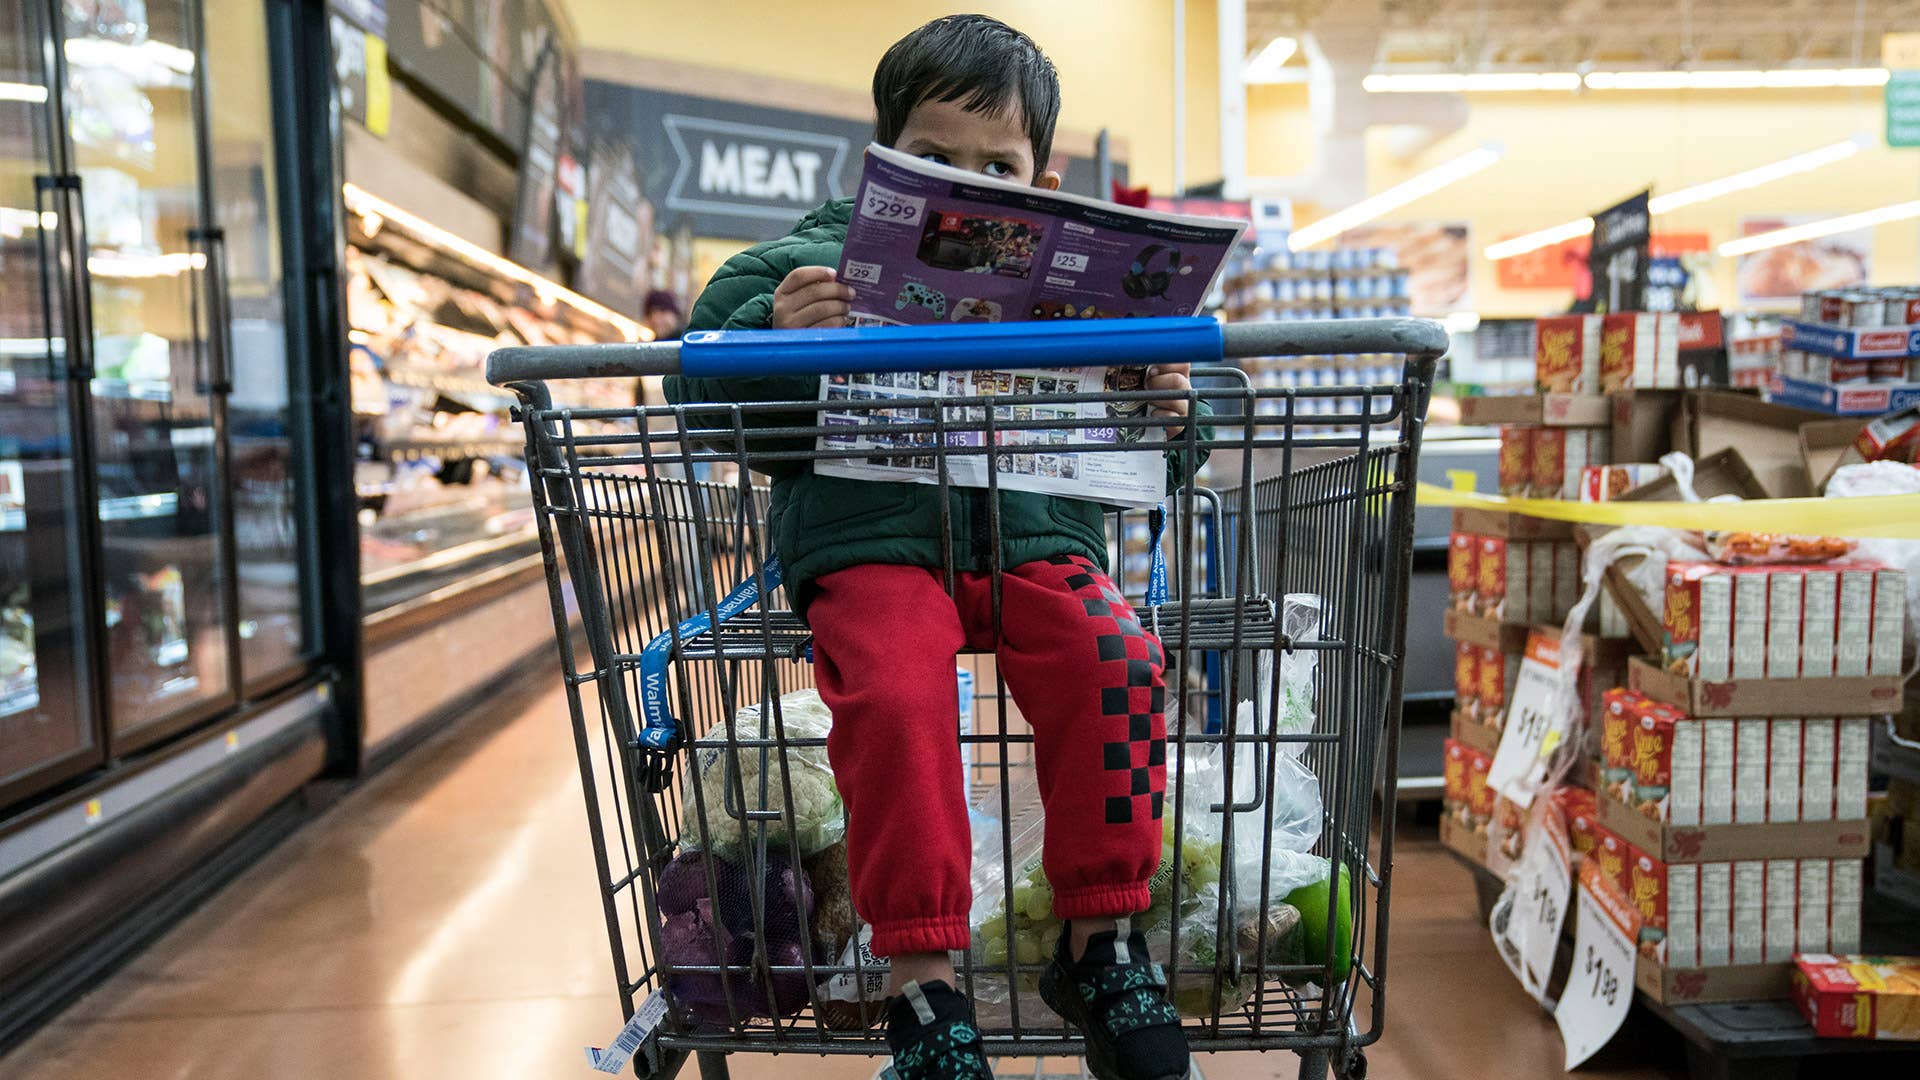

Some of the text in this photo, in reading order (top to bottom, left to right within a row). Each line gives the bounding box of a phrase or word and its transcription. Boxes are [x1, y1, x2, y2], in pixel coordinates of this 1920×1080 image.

[700, 138, 822, 202] MEAT
[867, 197, 917, 220] $299
[1057, 255, 1077, 268] $25
[849, 267, 870, 279] $29
[949, 435, 968, 447] $15
[860, 943, 875, 994] UNEATHED
